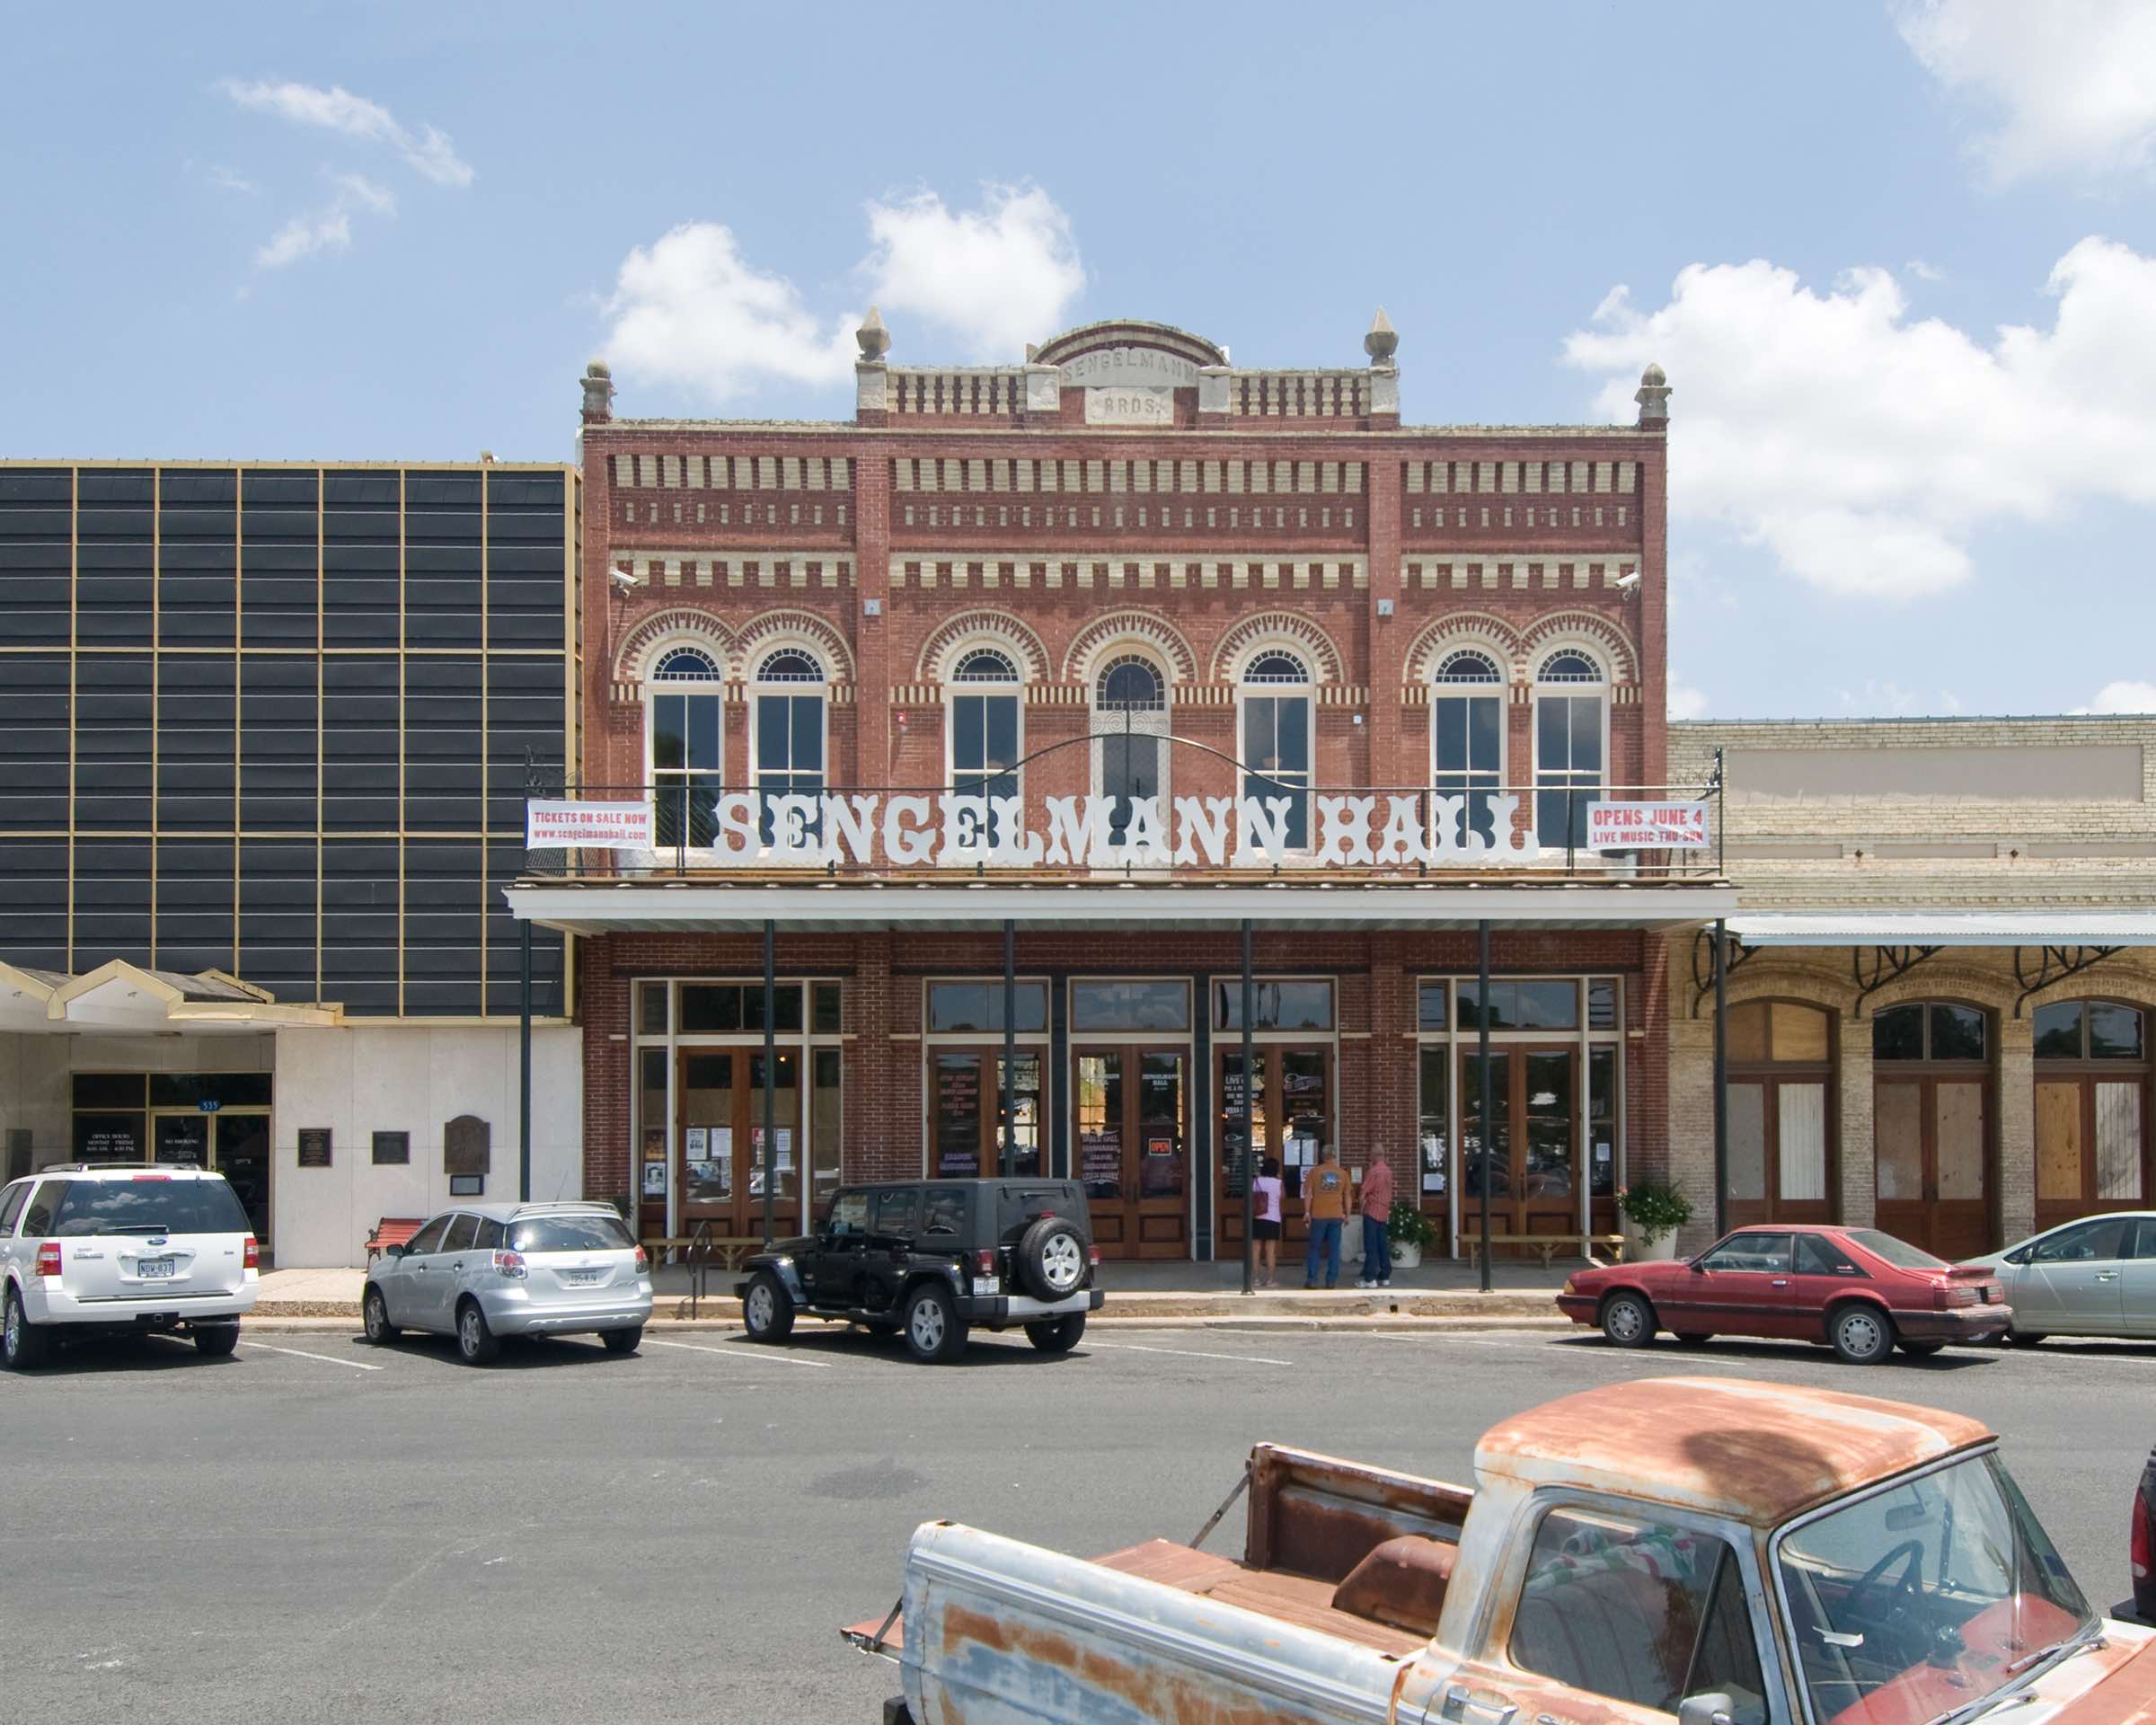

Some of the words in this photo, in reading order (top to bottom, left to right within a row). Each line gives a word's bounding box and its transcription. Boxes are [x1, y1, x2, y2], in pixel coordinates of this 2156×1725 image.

[1064, 351, 1197, 382] SENGELMANN
[534, 812, 577, 823] TICKETS
[580, 813, 593, 823] ON
[596, 813, 622, 824] SALE
[625, 814, 647, 824] NOW
[1594, 809, 1643, 826] OPENS
[1649, 809, 1687, 826] JUNE
[1692, 809, 1703, 825] 4
[534, 829, 647, 840] www.sengelmannhall.com
[712, 794, 1292, 865] SENGELMANN
[1317, 794, 1541, 865] HALL
[1594, 832, 1617, 843] LIVE
[1621, 831, 1654, 842] MUSIC
[1658, 831, 1703, 843] THU-SUN
[1151, 1142, 1169, 1152] OPEN
